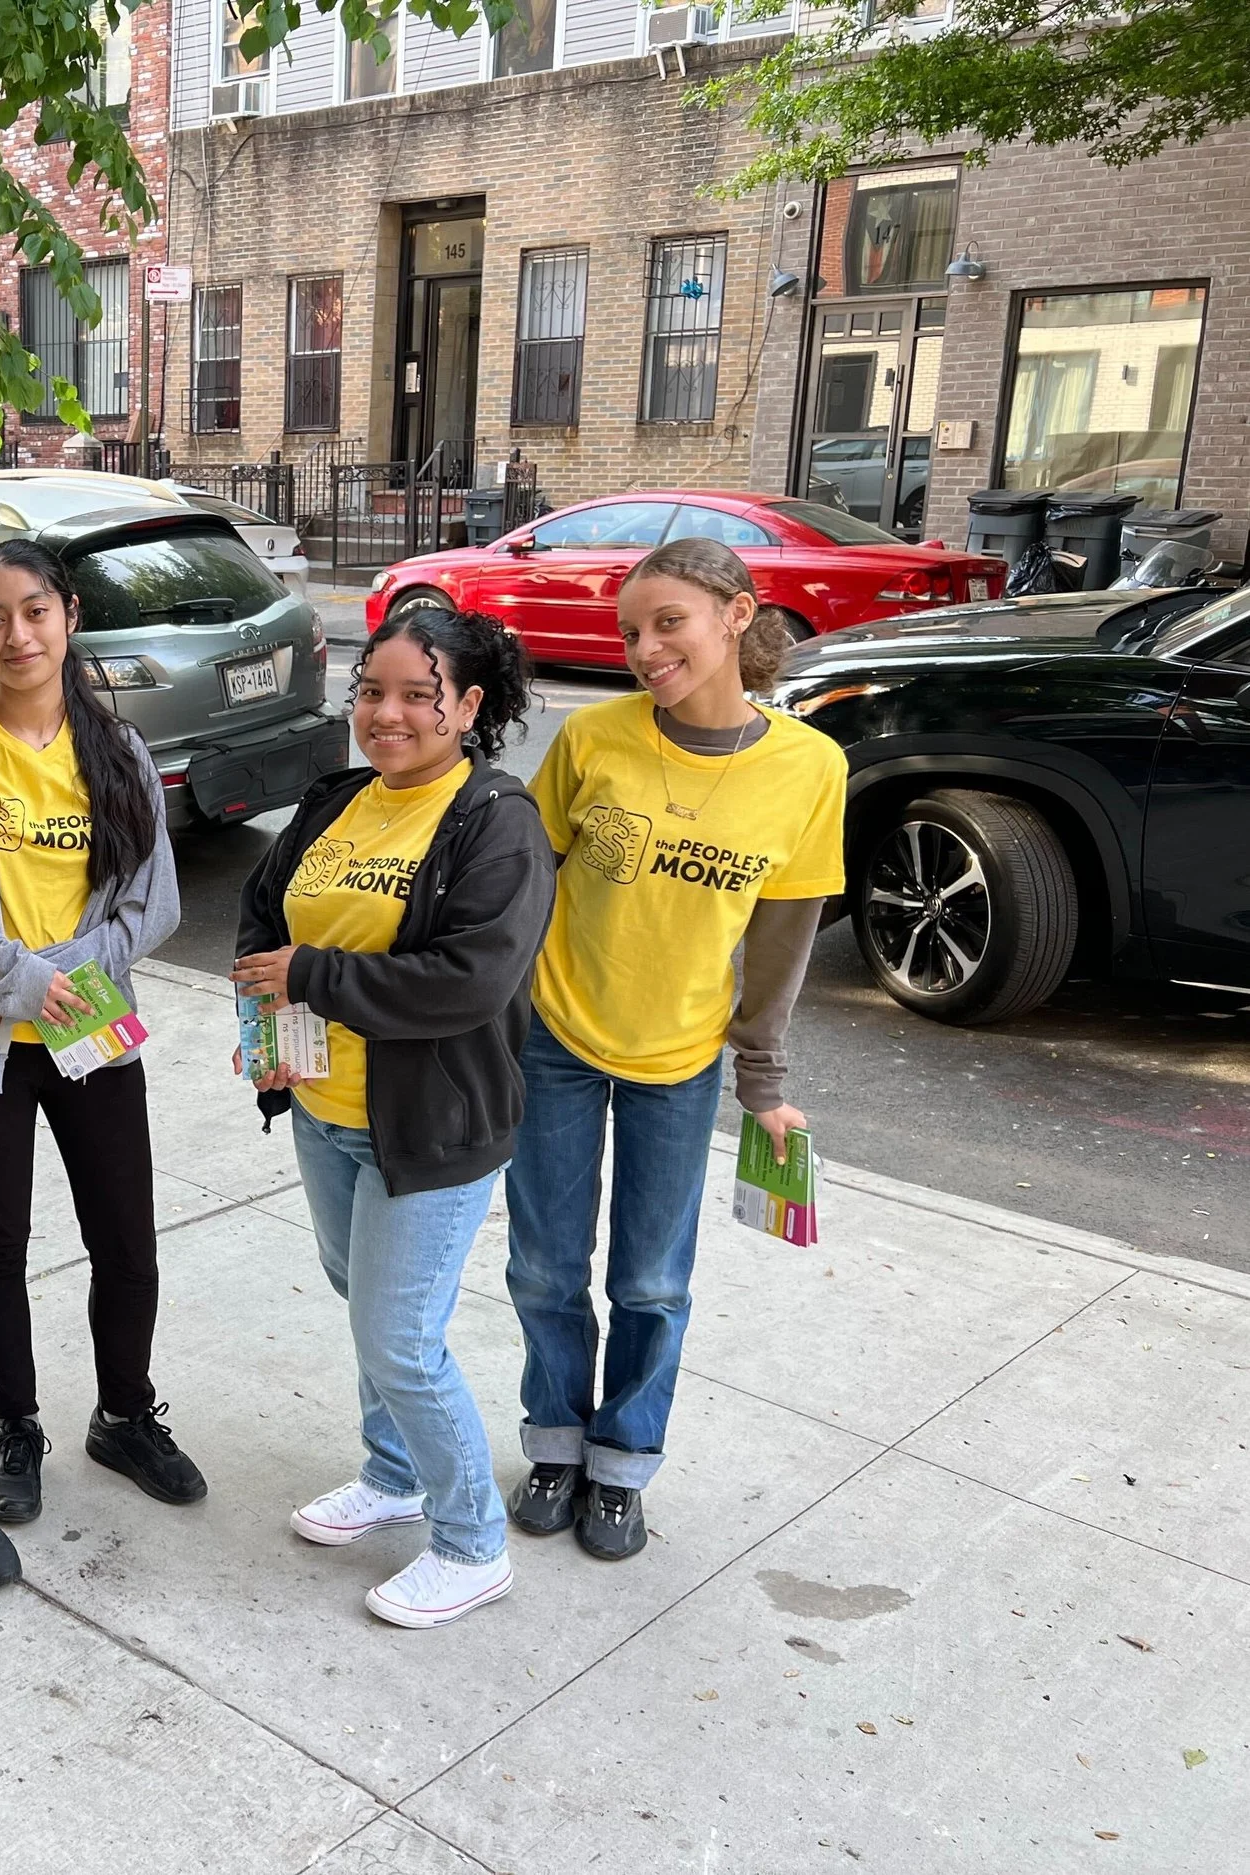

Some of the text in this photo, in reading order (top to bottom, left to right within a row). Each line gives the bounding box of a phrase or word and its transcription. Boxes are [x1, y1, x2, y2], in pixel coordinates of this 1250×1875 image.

[875, 224, 901, 244] 147
[445, 243, 465, 260] 145
[252, 667, 273, 691] 1448
[29, 815, 92, 831] the PEOP
[30, 831, 91, 850] MON
[655, 839, 676, 852] the
[348, 857, 419, 875] the PEOPLE
[650, 853, 760, 893] MONEY
[336, 871, 411, 900] MONE
